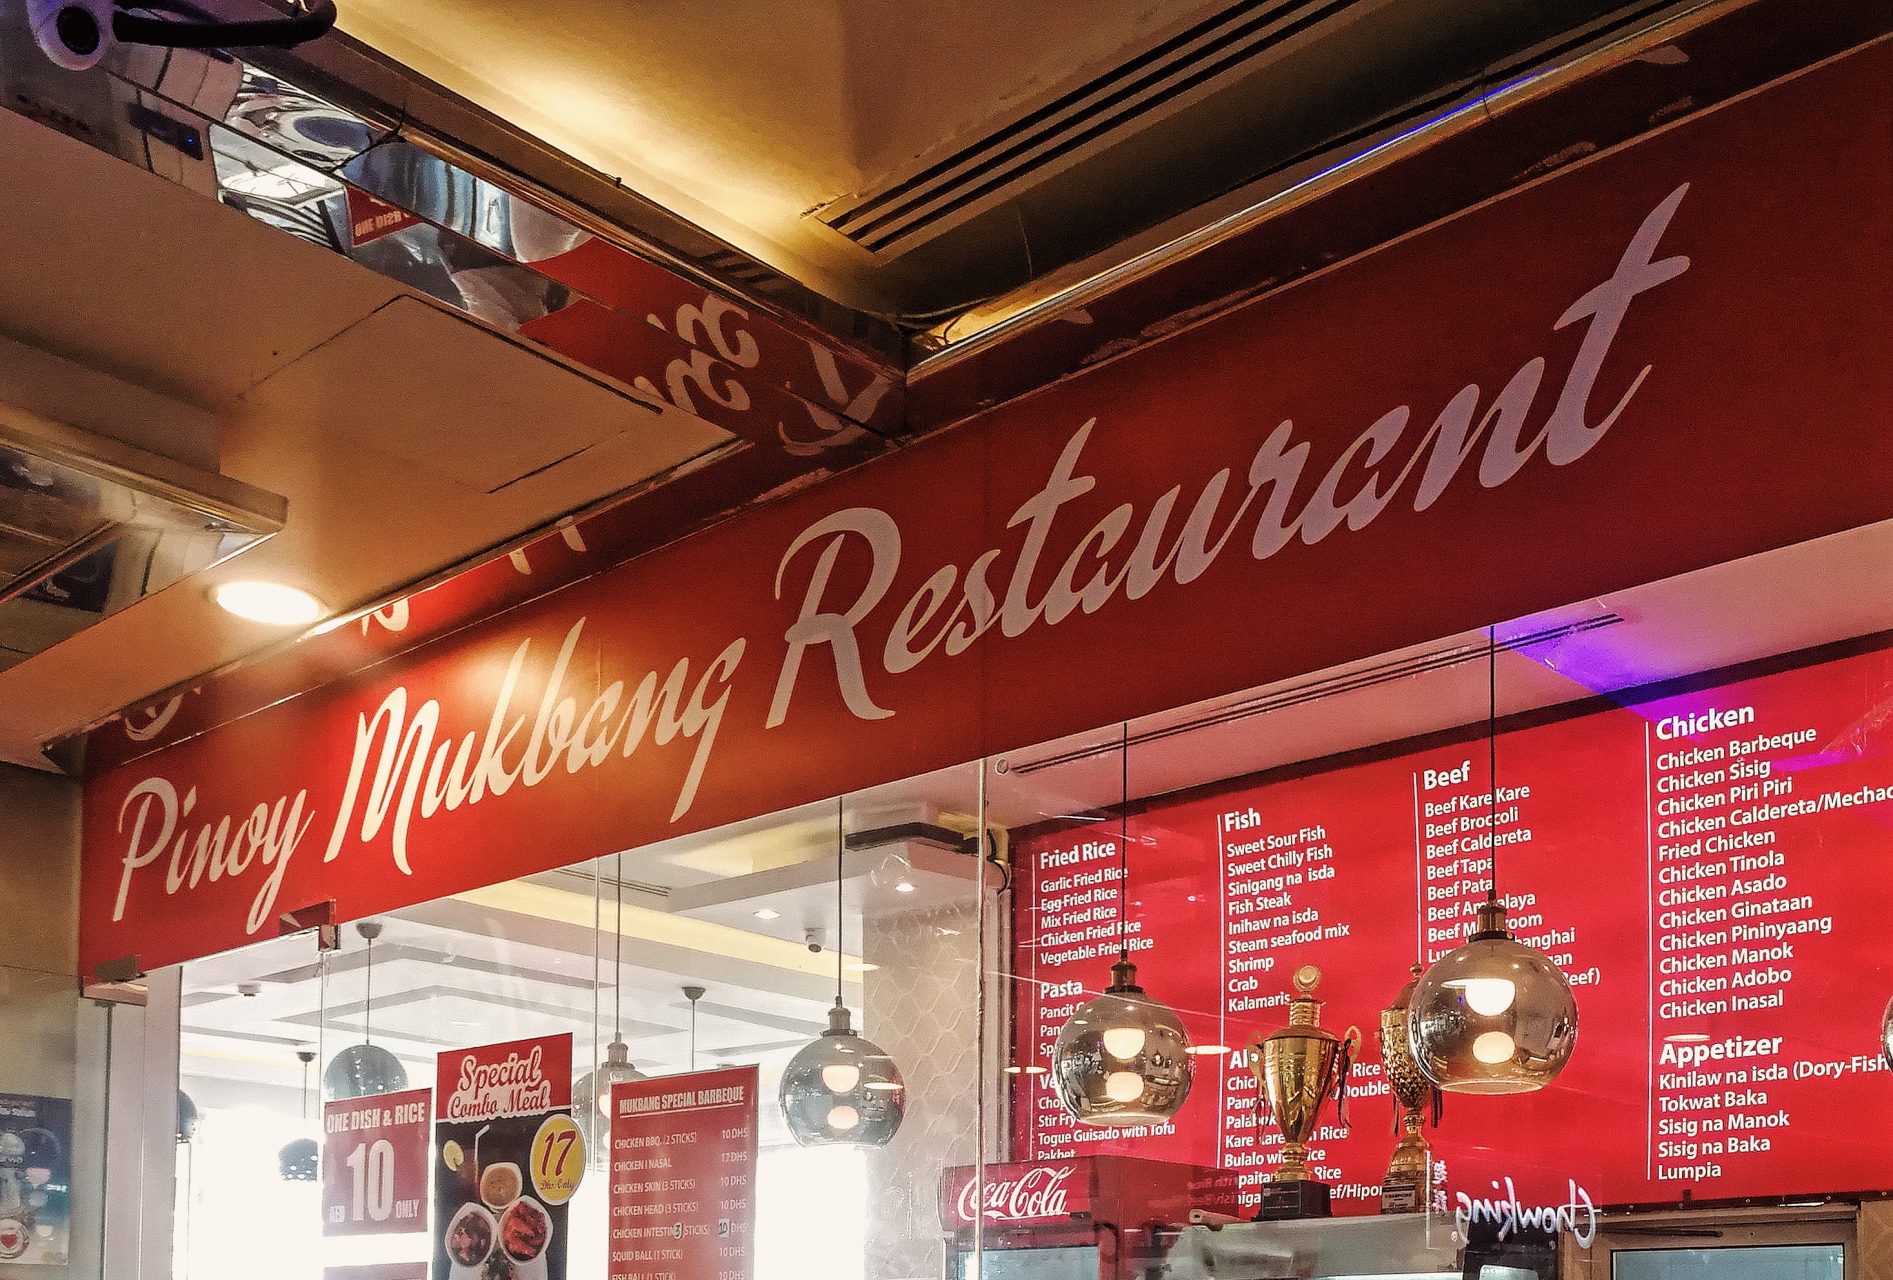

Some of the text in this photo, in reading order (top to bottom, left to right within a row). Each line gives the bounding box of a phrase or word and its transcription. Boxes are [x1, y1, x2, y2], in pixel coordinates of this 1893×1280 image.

[112, 182, 1692, 936] Pinoy Mukbang Restaurant
[1655, 705, 1754, 740] Chicken
[1656, 728, 1817, 771] Chicken Barbeque
[1423, 759, 1470, 790] Beef
[1655, 758, 1771, 793] Chicken Sisig
[1424, 785, 1530, 818] Beef Kare Kare
[1657, 775, 1792, 816] Chicken Piri Piri
[1224, 807, 1261, 832] Fish
[1425, 805, 1518, 839] Beef Broccoli
[1657, 815, 1726, 839] Chicken
[1039, 840, 1116, 869] Fried Rice
[1226, 824, 1326, 858] Sweet Sour Fish
[1425, 828, 1532, 860] Beef Caldereta
[1658, 830, 1775, 862] Fried Chicken
[1227, 843, 1333, 877] Sweet Chilly Fish
[1426, 859, 1459, 881] Beef
[1657, 849, 1785, 884] Chicken Tinola
[1040, 876, 1072, 893] Garlic
[1073, 868, 1103, 887] Fried
[1227, 863, 1335, 897] Sinigang na isda
[1427, 877, 1493, 901] Beef Pata
[1658, 872, 1787, 907] Chicken Asado
[1040, 887, 1118, 913] Egg Fried Rice
[1227, 891, 1292, 916] Fish Steak
[1427, 901, 1460, 922] Beef
[1658, 895, 1813, 929] Chicken Ginataan
[1040, 905, 1117, 929] Mix Fried Rice
[1228, 906, 1319, 935] Inihaw na isda
[1040, 930, 1084, 947] Chicken
[1085, 922, 1115, 940] Fried
[1227, 922, 1350, 955] Steam seafood mix
[1427, 922, 1461, 943] Beef
[1659, 916, 1832, 952] Chicken Pininyaang
[1040, 936, 1154, 967] Vegetable Fried Rice
[1227, 956, 1275, 974] Shrimp
[1659, 941, 1794, 974] Chicken Manok
[1039, 979, 1083, 1000] Pasta
[1227, 975, 1259, 993] Crab
[1658, 966, 1792, 997] Chicken Adobo
[1039, 1002, 1075, 1020] Pancit
[1228, 990, 1290, 1012] Kalamaris
[1659, 988, 1783, 1019] Chicken Inasal
[1658, 1036, 1783, 1068] Appetizer
[459, 1048, 542, 1101] Special
[1352, 1061, 1381, 1078] Rice
[1659, 1070, 1722, 1090] Kinilaw
[1725, 1070, 1747, 1084] na
[1751, 1063, 1788, 1082] isda
[450, 1085, 548, 1120] Combo Meal
[620, 1086, 744, 1114] MUKBANG SPECIAL BARBEQUE
[1658, 1088, 1767, 1113] Tokwat Baka
[326, 1102, 425, 1133] ONE DISH & RICE
[1037, 1111, 1076, 1129] Stir Fry
[1657, 1109, 1790, 1136] Sisig na Manok
[1037, 1121, 1174, 1148] Togue Guisado with Tofu
[1224, 1125, 1348, 1149] Kare Rice
[1657, 1134, 1770, 1159] Sisig na Baka
[541, 1130, 577, 1177] 17
[1223, 1150, 1264, 1168] Bulalo
[346, 1139, 394, 1221] 10
[720, 1175, 747, 1187] 10 DHS
[1658, 1161, 1721, 1182] Lumpia
[613, 1182, 644, 1194] CHICKEN
[645, 1181, 660, 1192] SKIN
[958, 1164, 1078, 1221] Coca-Cola
[396, 1199, 420, 1219] ONLY
[613, 1204, 664, 1217] CHICKEN HEAD
